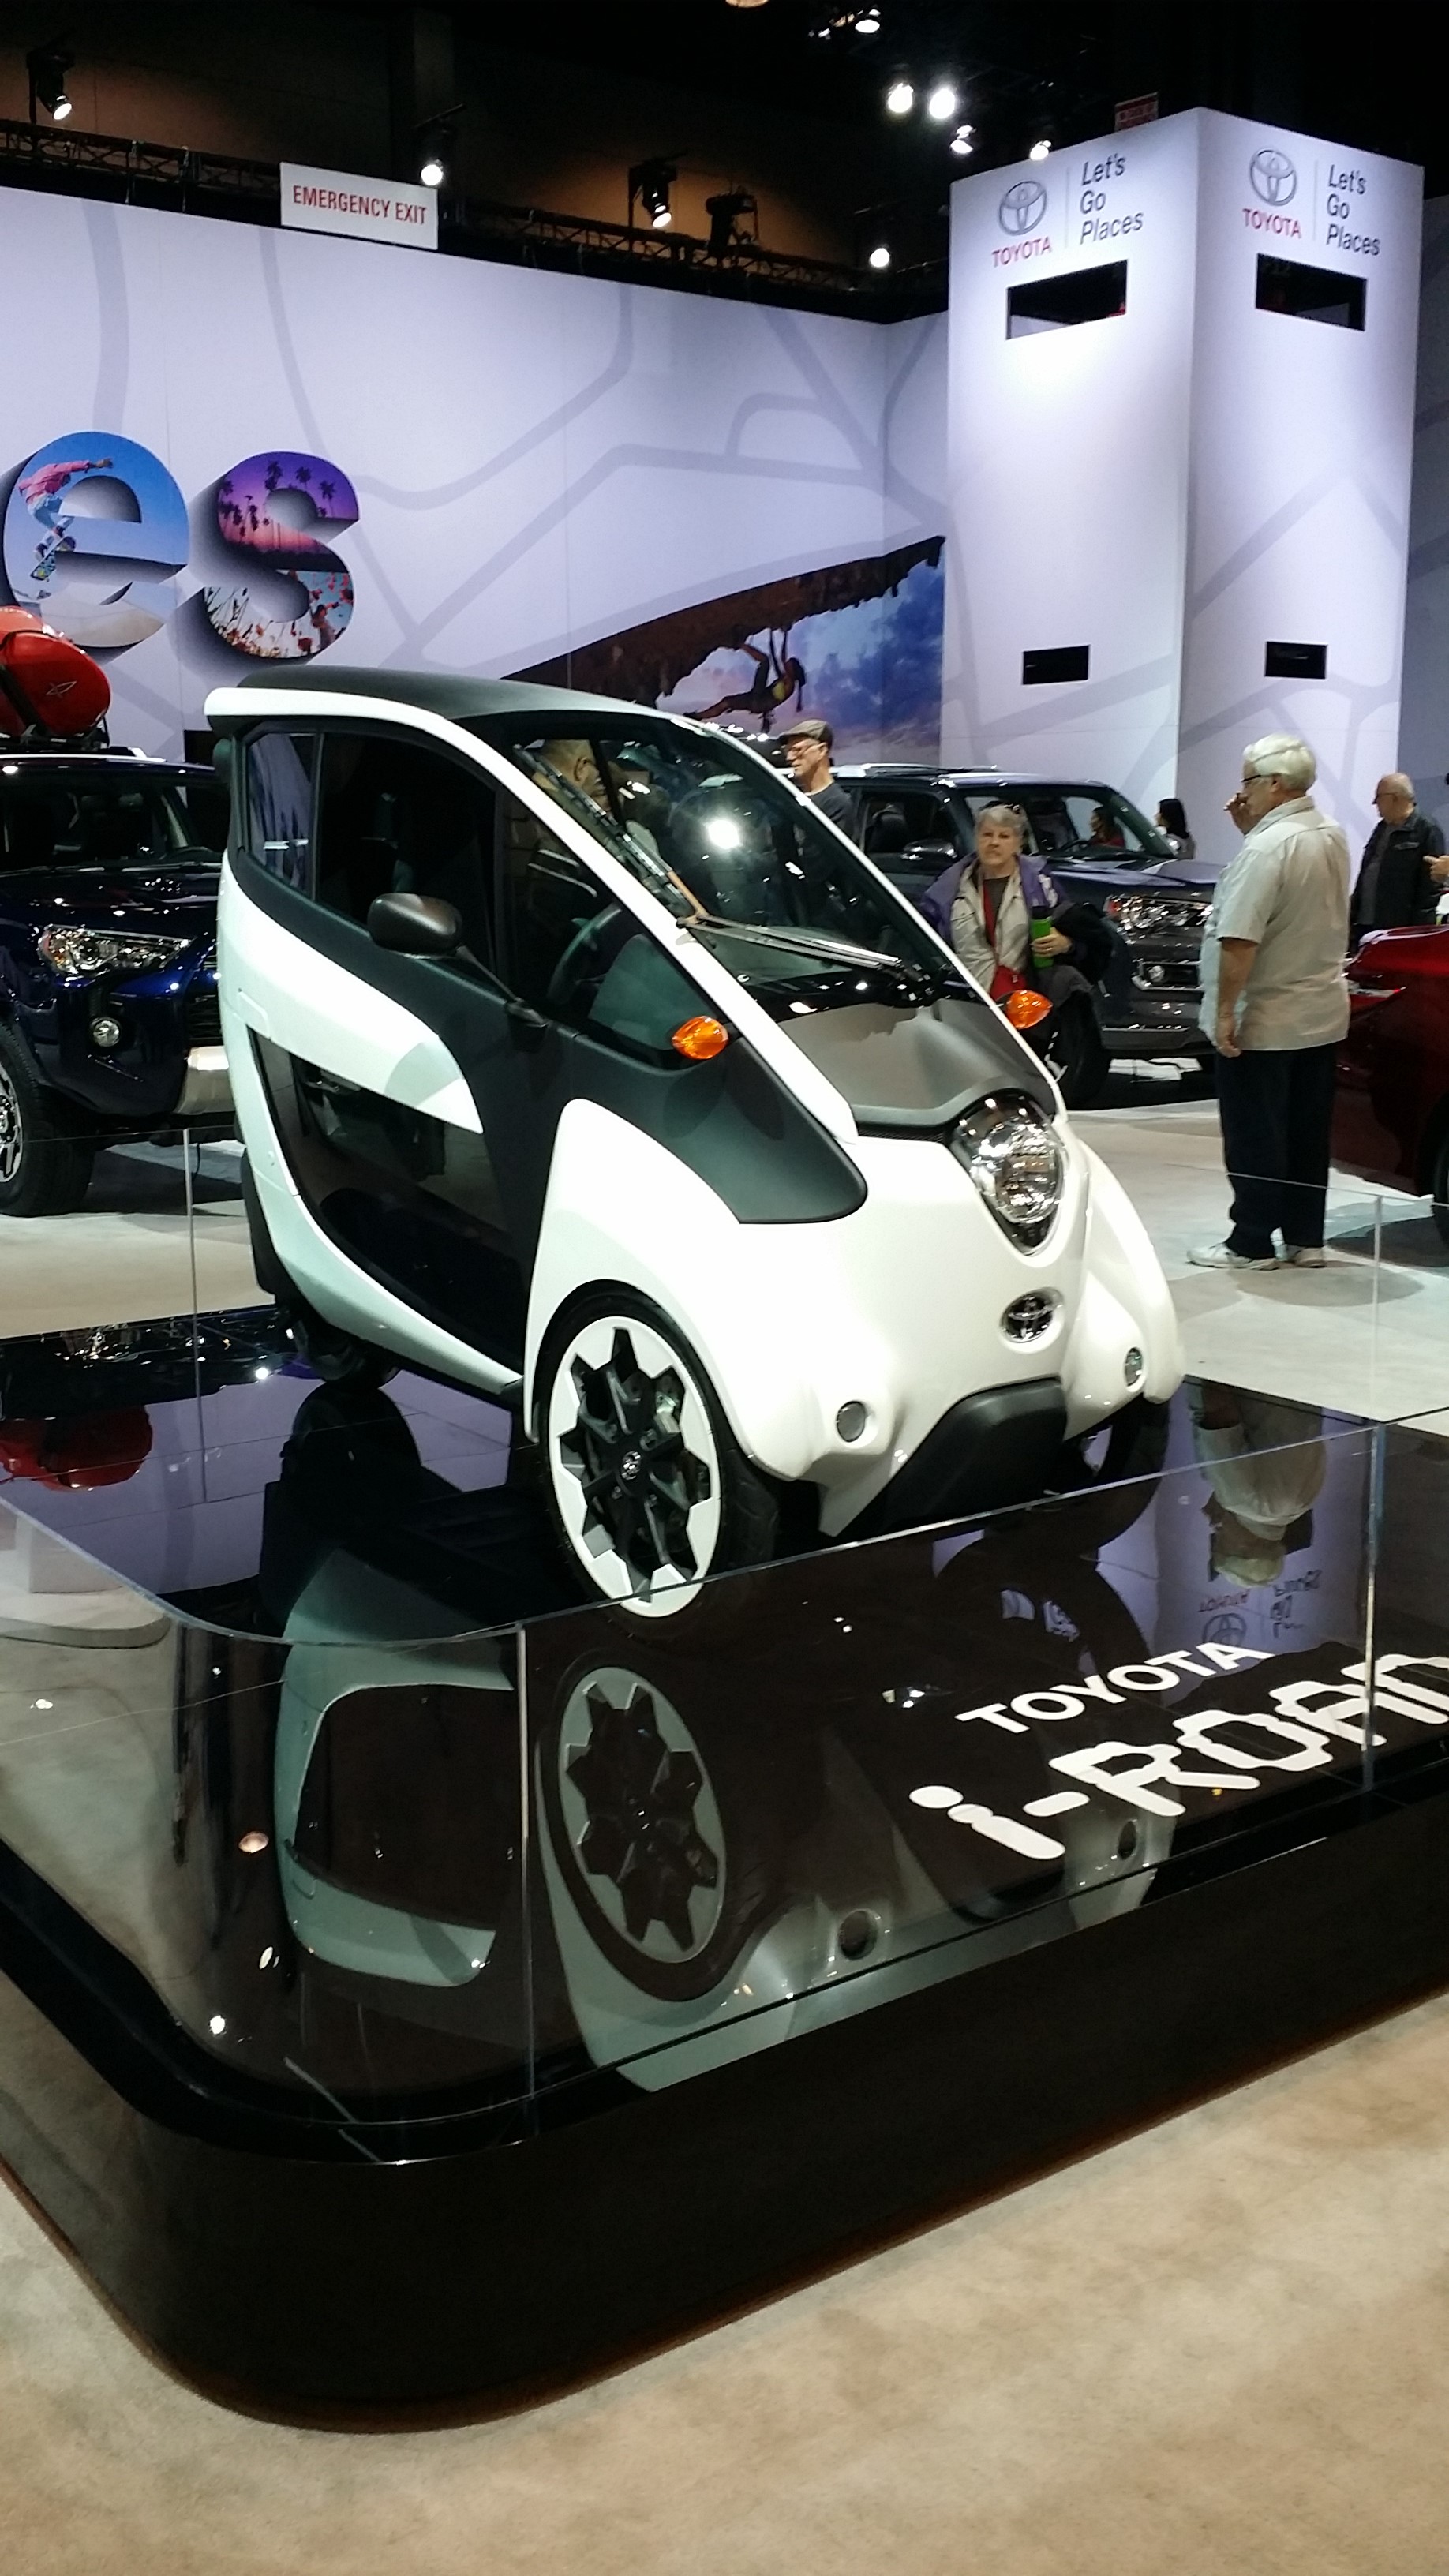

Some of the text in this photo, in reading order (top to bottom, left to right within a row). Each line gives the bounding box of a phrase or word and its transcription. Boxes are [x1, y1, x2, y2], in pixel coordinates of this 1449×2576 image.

[1081, 153, 1127, 186] Let's
[1328, 164, 1367, 195] Let's
[293, 185, 427, 225] EMERGENCY EXIT
[1080, 190, 1107, 215] Go
[1327, 193, 1350, 219] Go
[1080, 212, 1144, 245] Places
[1242, 208, 1302, 239] TOYOTA
[1326, 223, 1382, 256] Places
[992, 237, 1053, 268] TOYOTA
[954, 1642, 1276, 1734] TOYOTA
